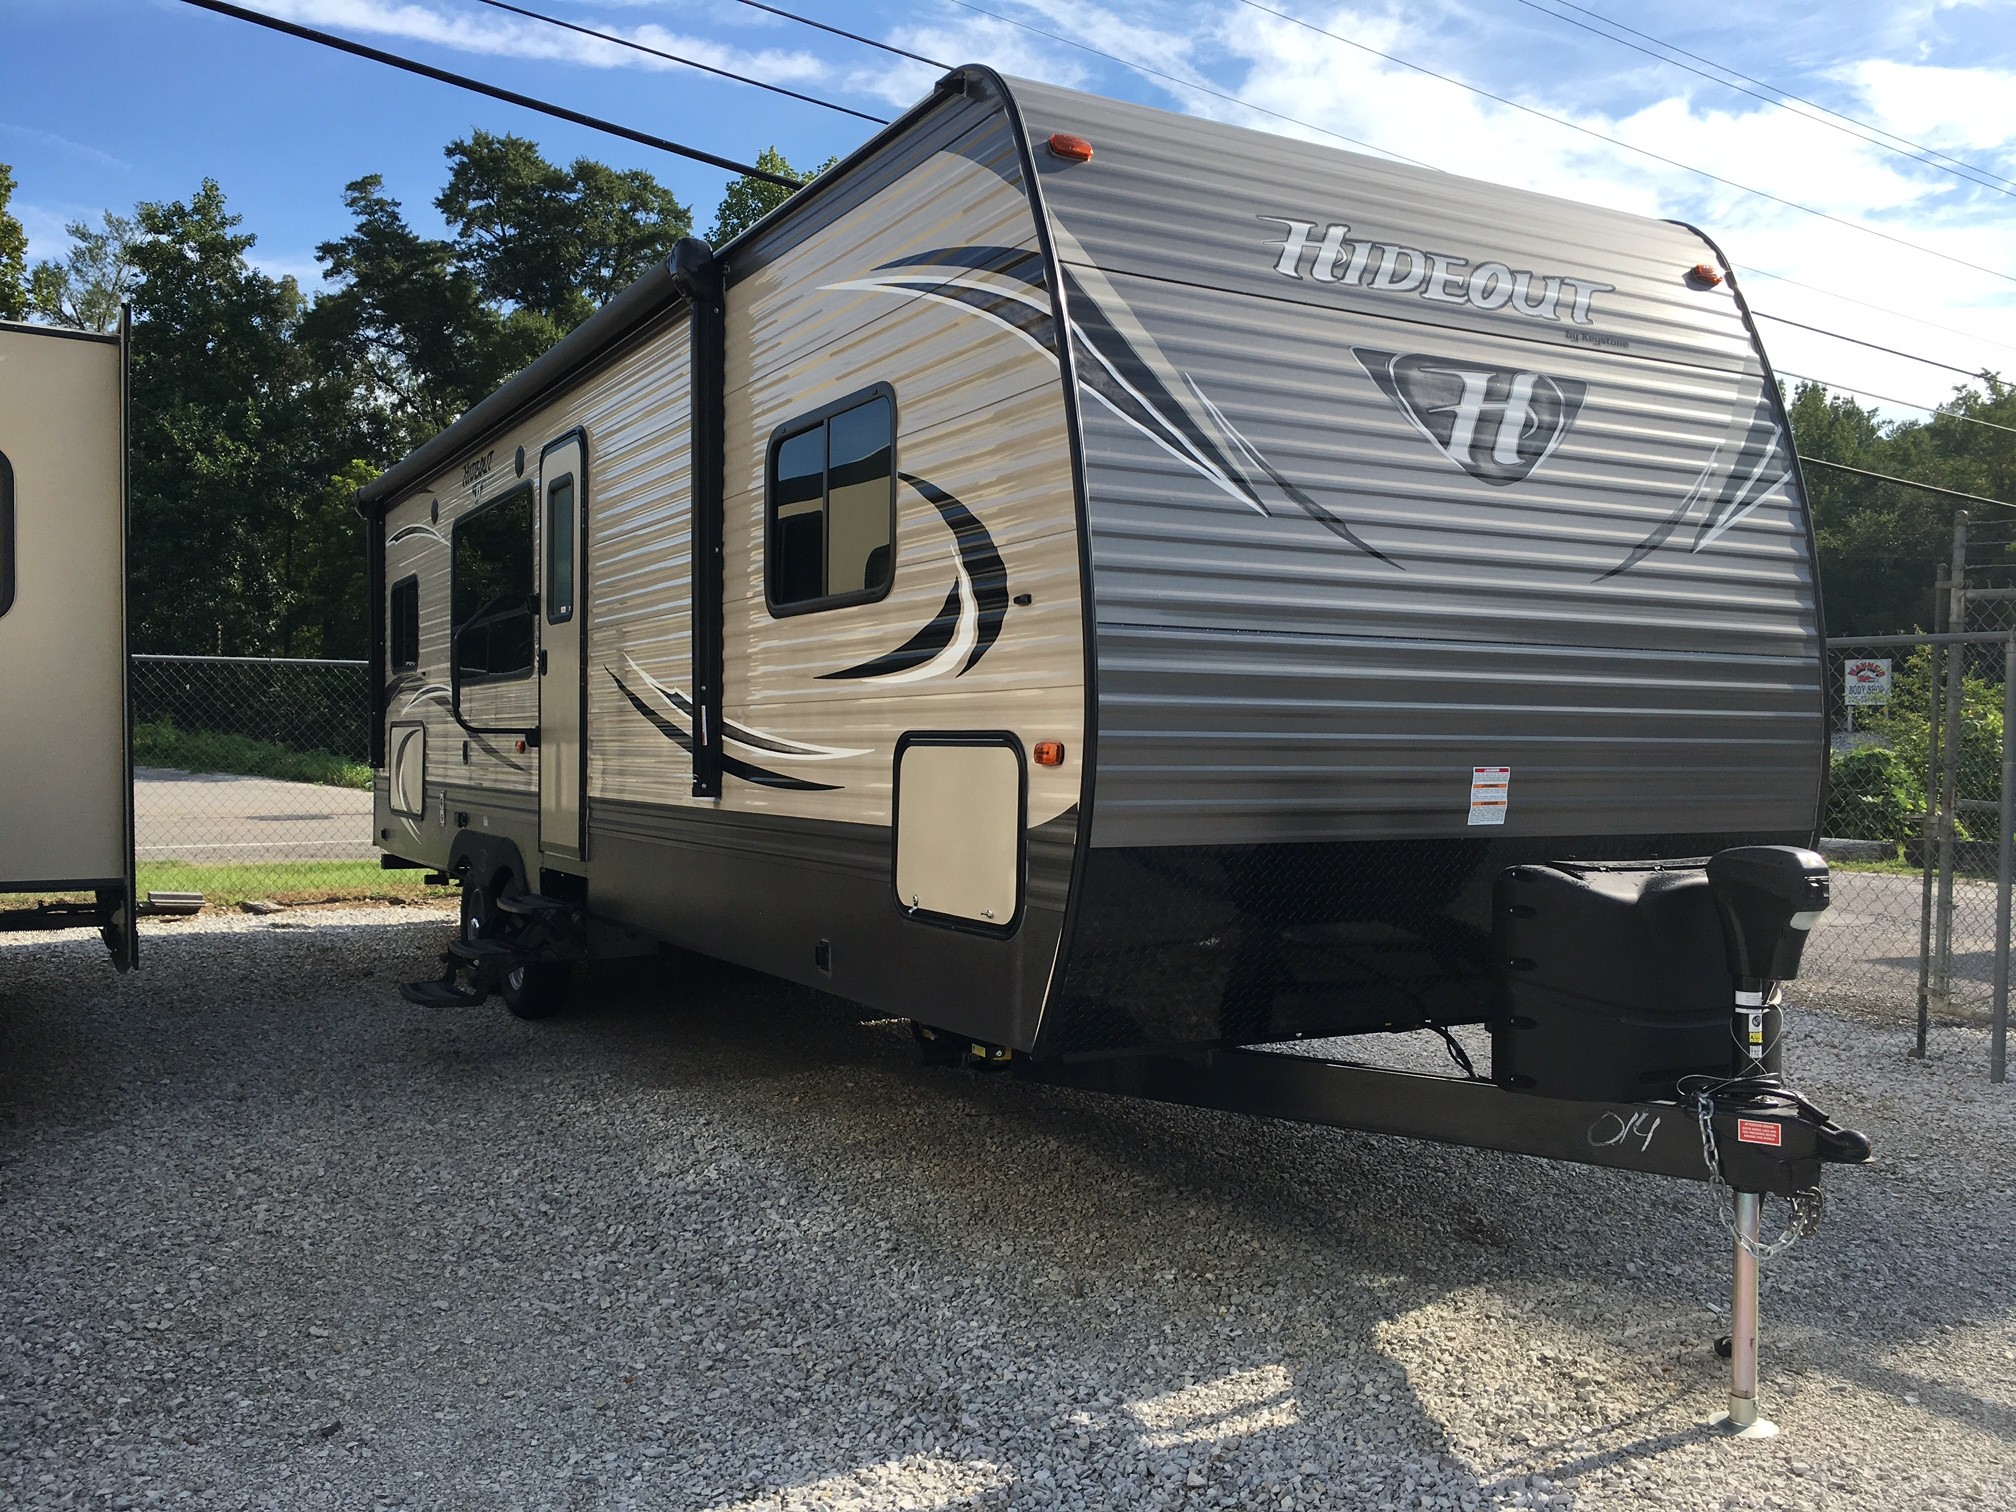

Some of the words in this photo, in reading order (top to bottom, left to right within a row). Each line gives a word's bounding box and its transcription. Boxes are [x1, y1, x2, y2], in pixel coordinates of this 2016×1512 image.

[1256, 214, 1616, 325] HIDEOUT
[1565, 329, 1579, 342] by
[1581, 332, 1629, 348] Keystone
[1419, 366, 1539, 466] H
[1849, 685, 1866, 695] BODY
